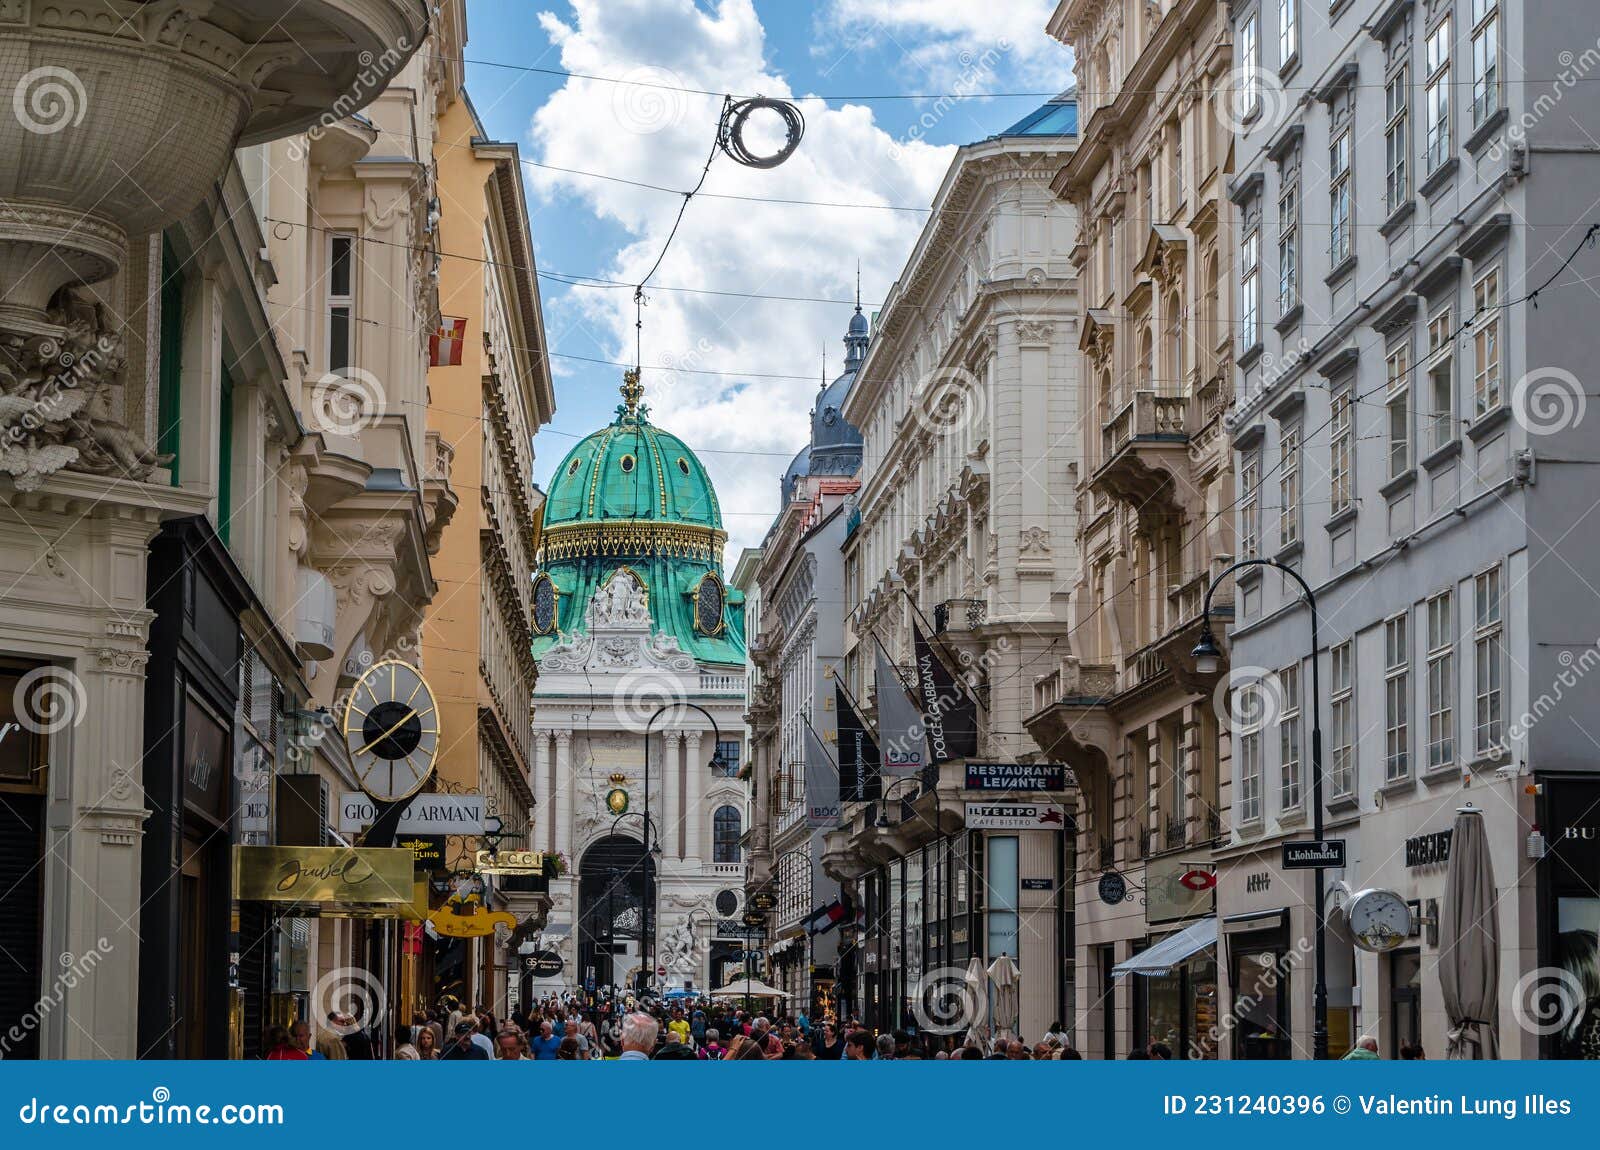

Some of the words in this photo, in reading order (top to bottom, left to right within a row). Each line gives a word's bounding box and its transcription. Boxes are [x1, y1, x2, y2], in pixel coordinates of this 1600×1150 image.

[968, 766, 1061, 776] RESTAURANT
[983, 777, 1047, 788] LEVANTE
[344, 804, 412, 820] GIOO
[417, 806, 480, 822] ARMANI
[814, 807, 839, 818] BDO
[982, 807, 1036, 816] TEMPO
[1405, 829, 1454, 868] BREGUE
[277, 856, 374, 892] Juwel
